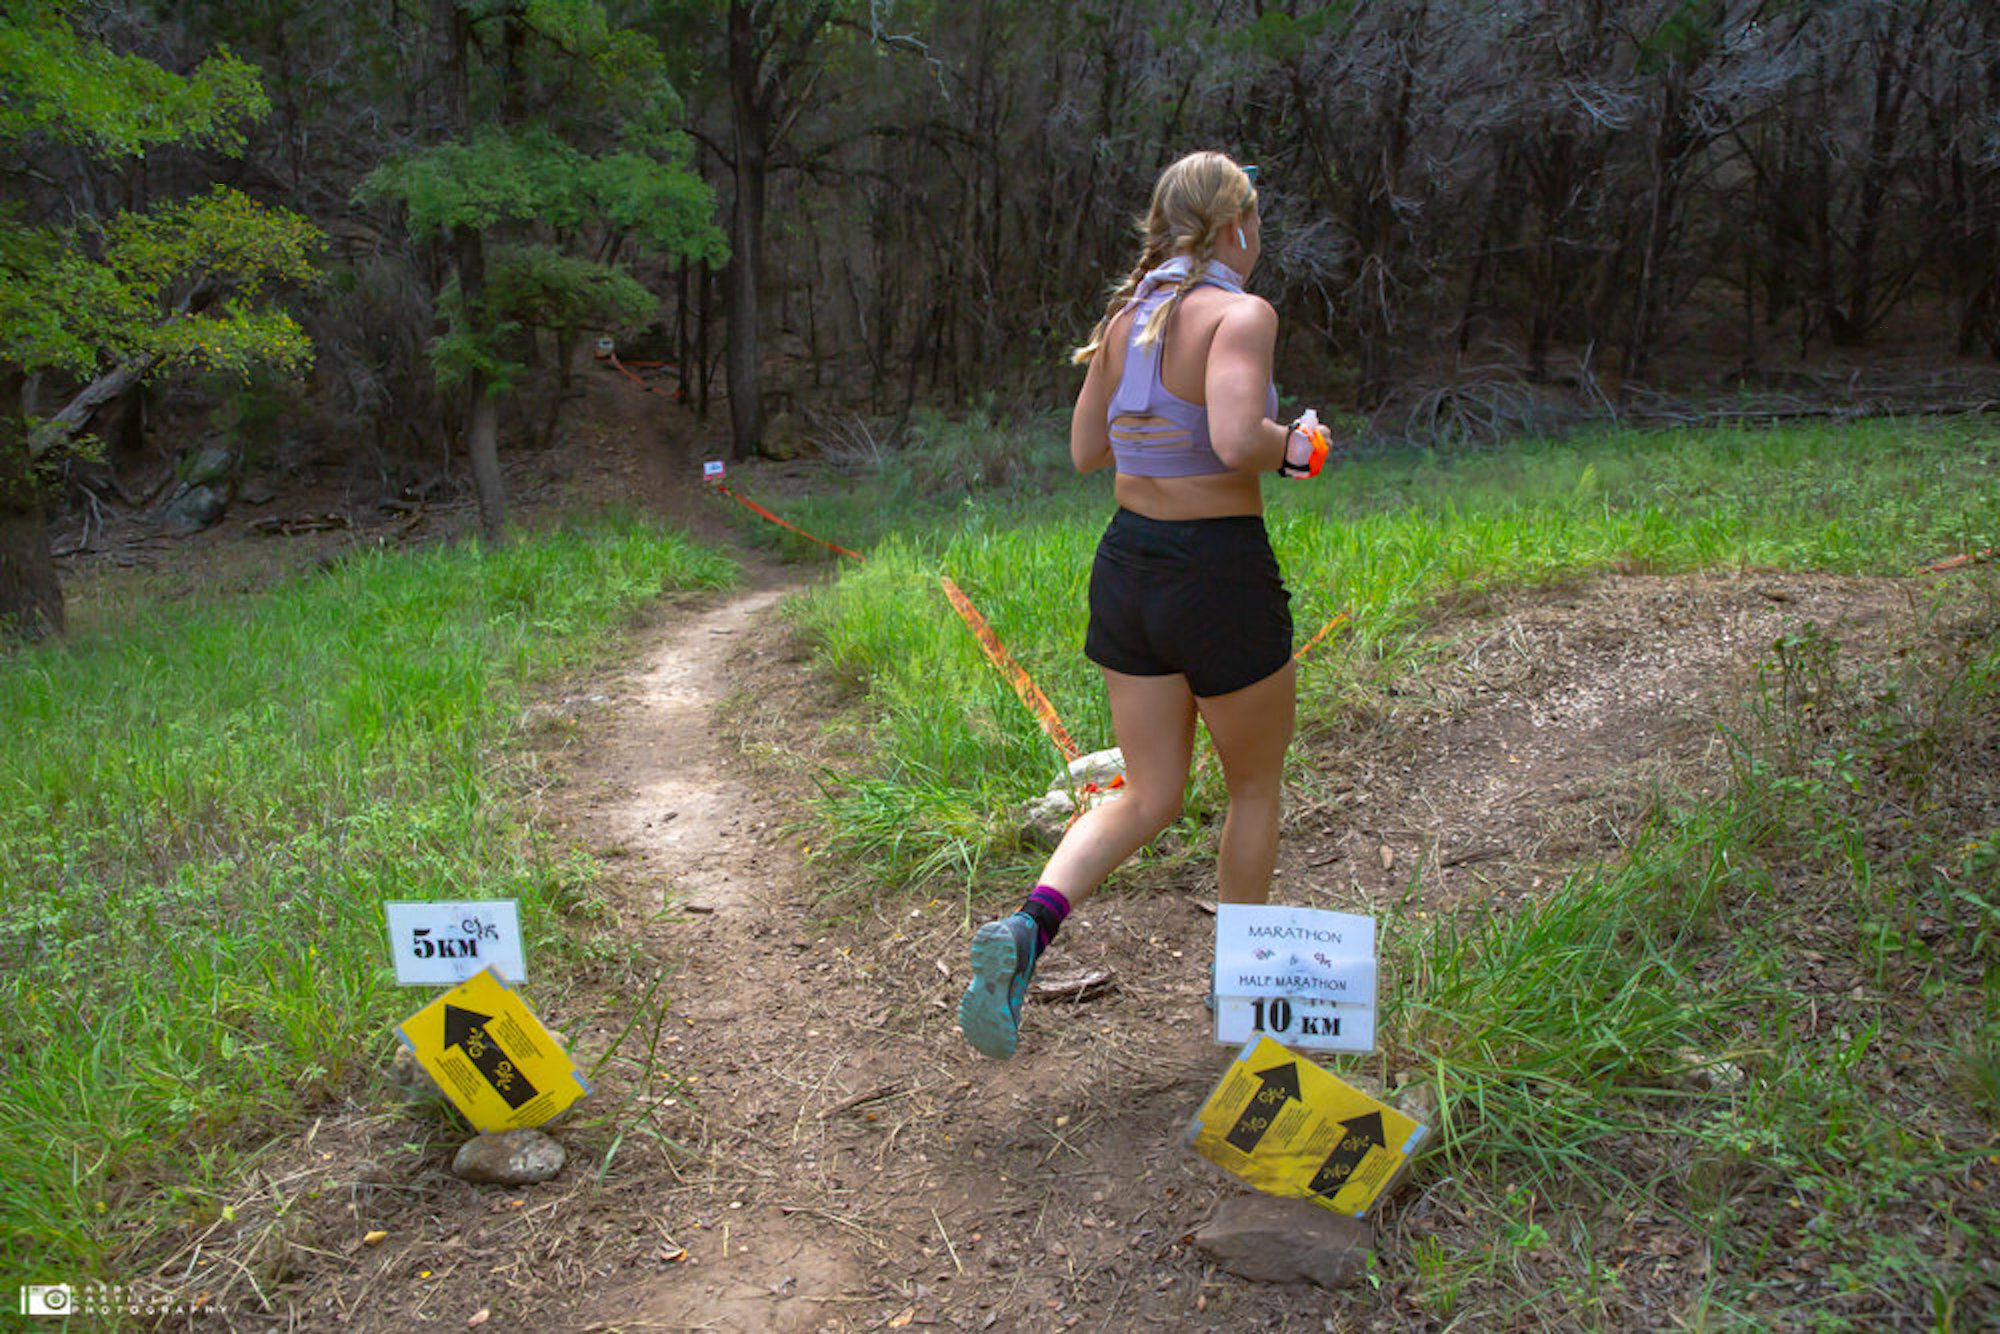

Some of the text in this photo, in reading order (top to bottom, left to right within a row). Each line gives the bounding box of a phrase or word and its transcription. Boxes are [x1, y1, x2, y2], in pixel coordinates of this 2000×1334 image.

[1249, 926, 1343, 944] MARATHON
[1239, 975, 1347, 991] HALF MARATHON
[1251, 997, 1342, 1036] 10 KM
